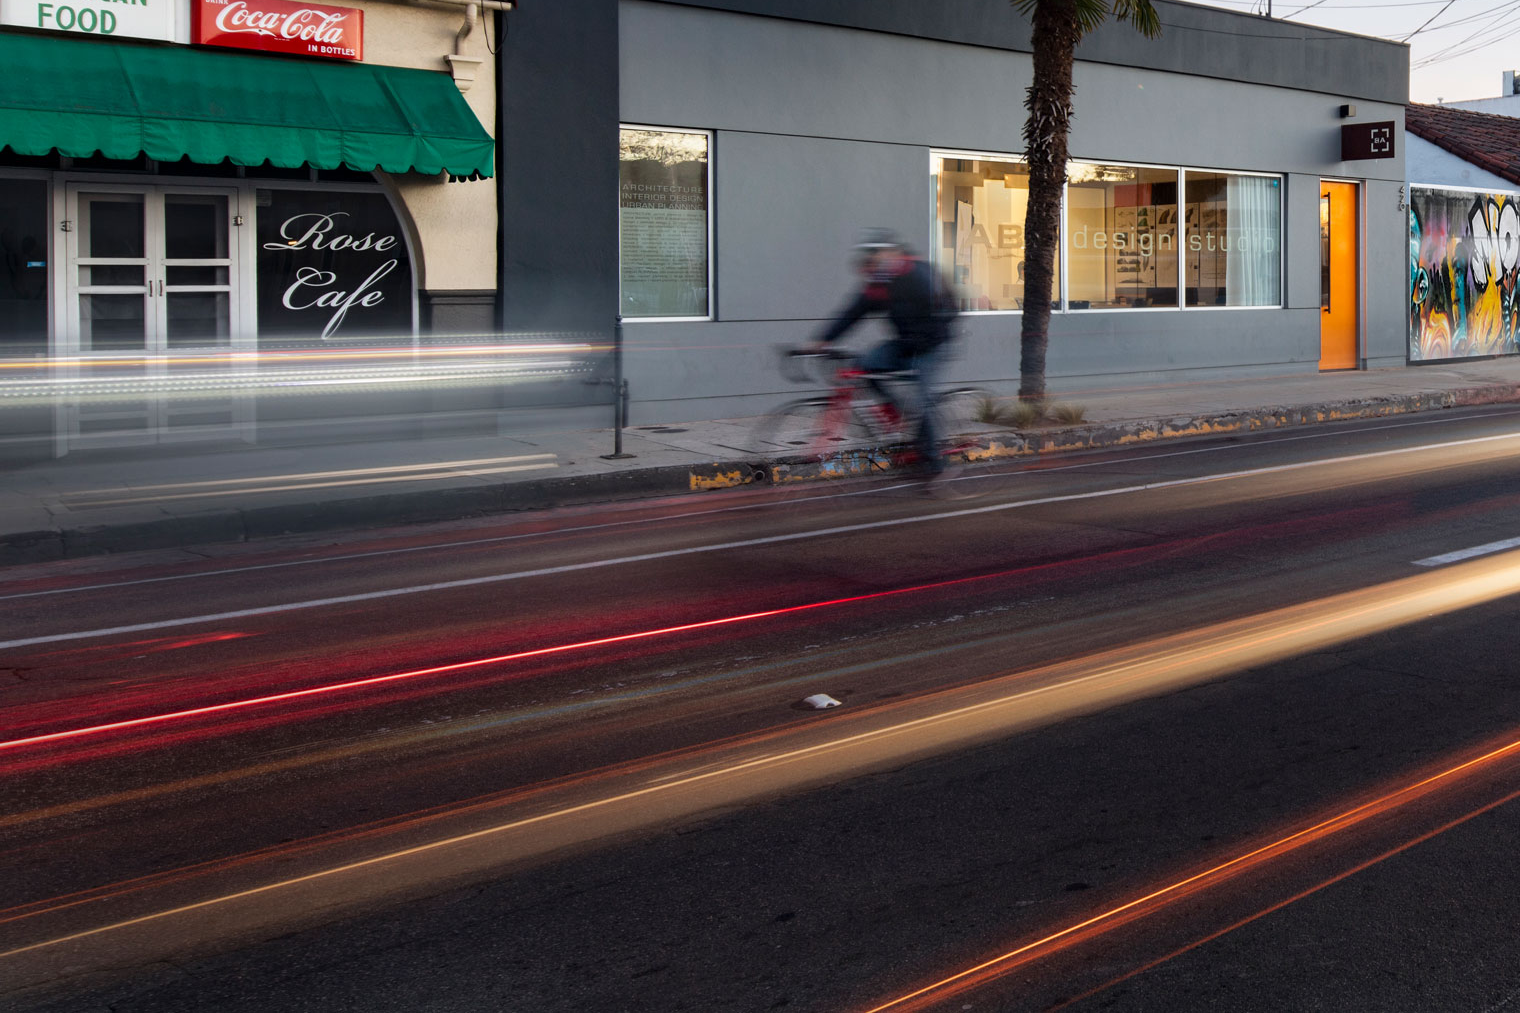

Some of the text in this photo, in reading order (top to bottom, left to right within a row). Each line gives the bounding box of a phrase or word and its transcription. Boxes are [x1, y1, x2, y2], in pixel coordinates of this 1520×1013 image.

[38, 3, 117, 34] FOOD
[215, 1, 349, 44] Coca-Cola
[308, 44, 356, 56] IN BOTTLES
[622, 184, 704, 193] ARCHITECTURE
[622, 193, 704, 202] INTERIOR DESIGN
[263, 211, 398, 251] Rose
[1073, 225, 1172, 257] design
[1189, 229, 1275, 253] studio
[282, 258, 398, 340] Cafe
